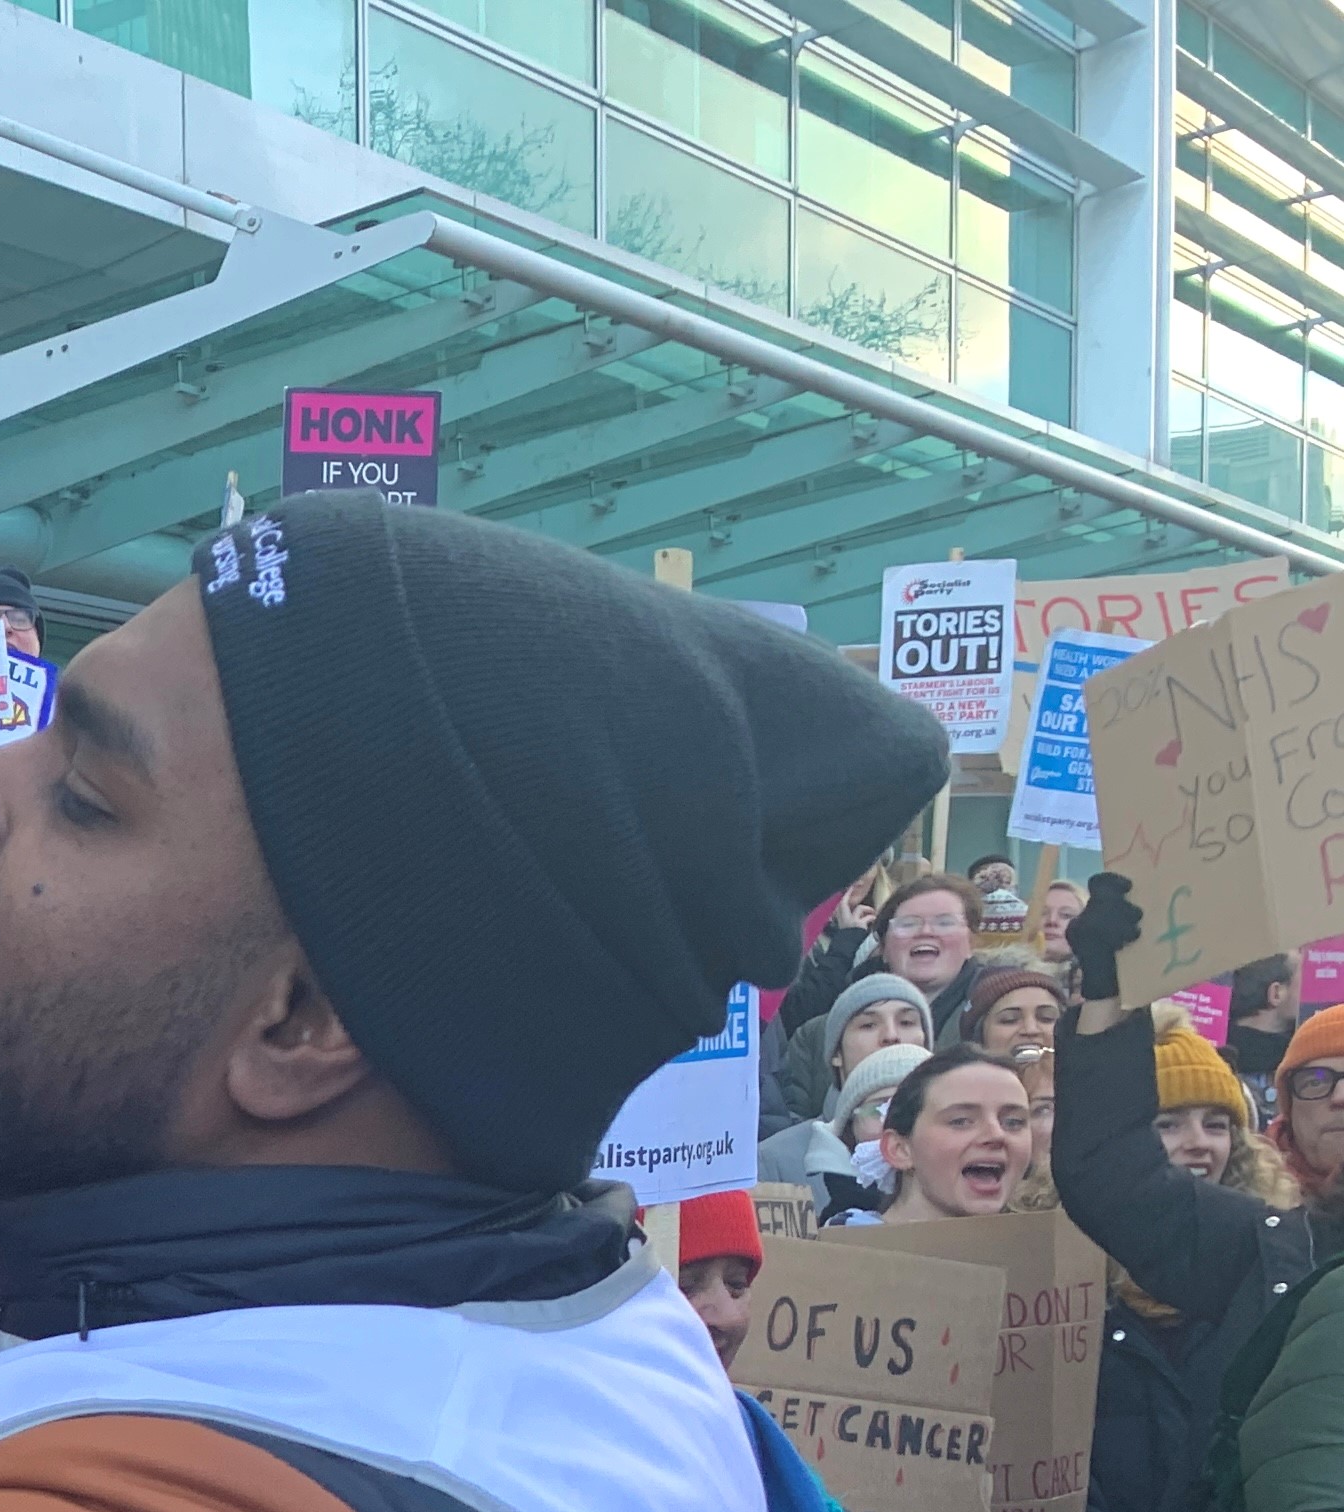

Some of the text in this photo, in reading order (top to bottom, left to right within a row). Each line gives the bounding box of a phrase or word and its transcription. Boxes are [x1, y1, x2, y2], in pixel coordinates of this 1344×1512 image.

[301, 407, 424, 445] HONK
[322, 461, 399, 486] IF YOU
[249, 530, 290, 608] College
[914, 587, 954, 598] Party
[919, 578, 971, 589] Socialist
[897, 609, 1001, 639] TORIES
[896, 636, 1000, 674] OUT!
[1053, 649, 1089, 664] HEALTH
[956, 677, 994, 686] LABOUR
[966, 687, 985, 695] FOR
[1167, 621, 1320, 742] NHS
[958, 699, 987, 710] NEW
[959, 710, 999, 720] PARTY
[1041, 711, 1076, 733] OUR
[767, 1296, 917, 1376] OF US
[1062, 1326, 1088, 1364] US
[833, 1404, 989, 1466] CANCER
[1032, 1451, 1085, 1500] CARE
